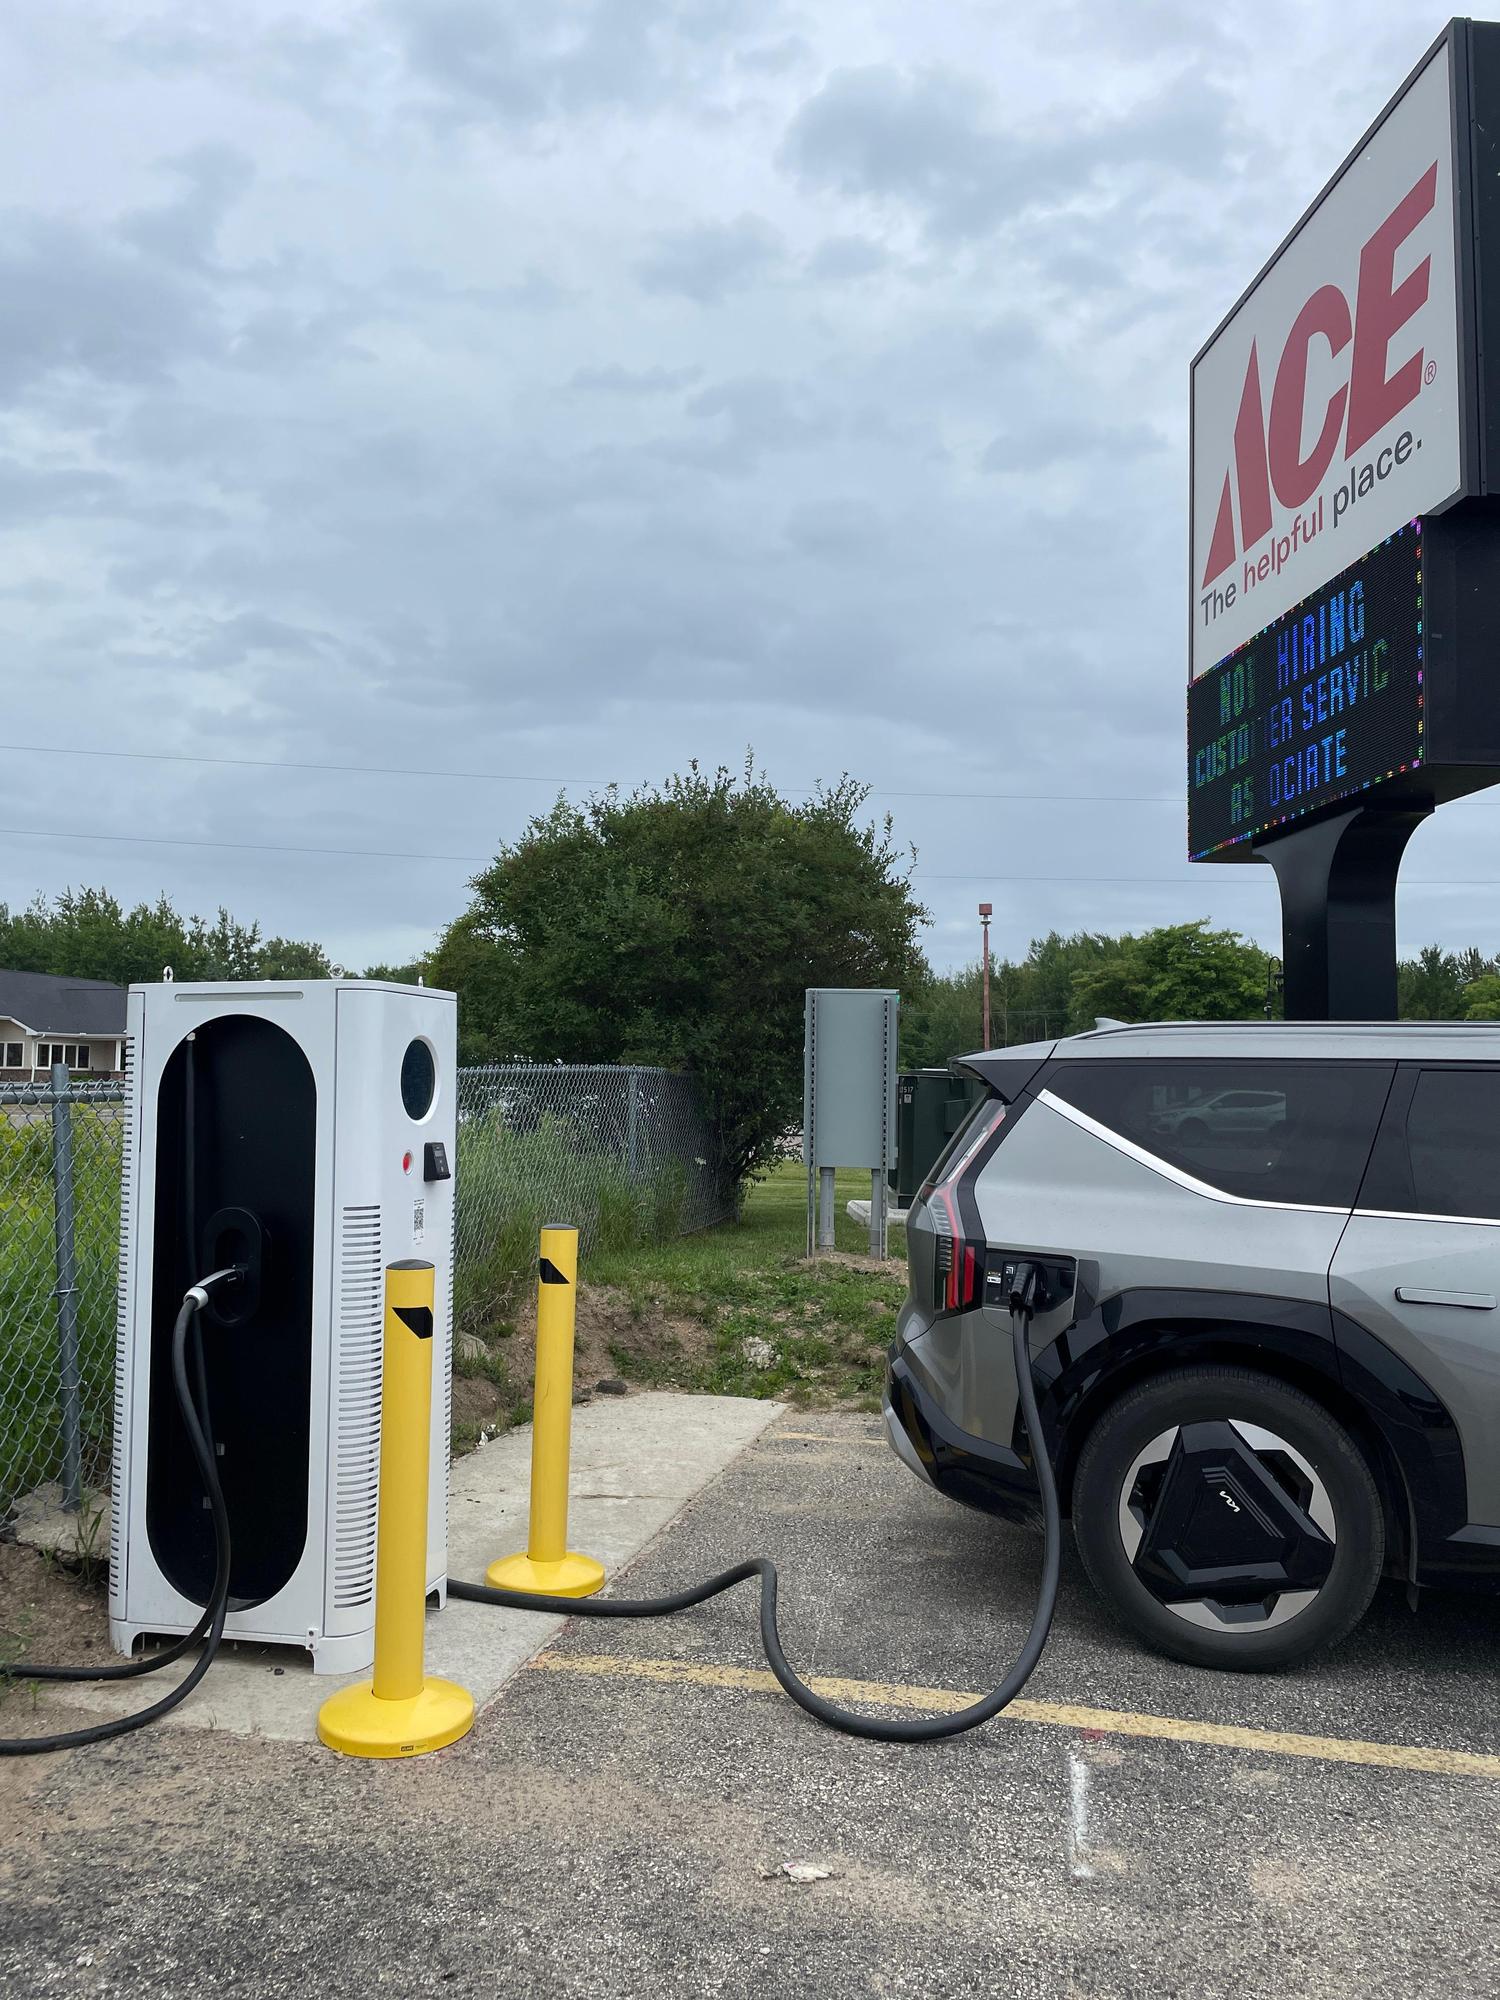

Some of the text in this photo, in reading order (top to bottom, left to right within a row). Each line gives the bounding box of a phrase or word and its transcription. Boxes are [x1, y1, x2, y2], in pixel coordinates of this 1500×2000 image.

[1202, 159, 1438, 590] ACE
[1201, 430, 1422, 627] The helpful place.
[1276, 579, 1366, 690] HIRING
[1195, 696, 1294, 790] CUSTOER
[1231, 728, 1349, 825] ASOCIATE
